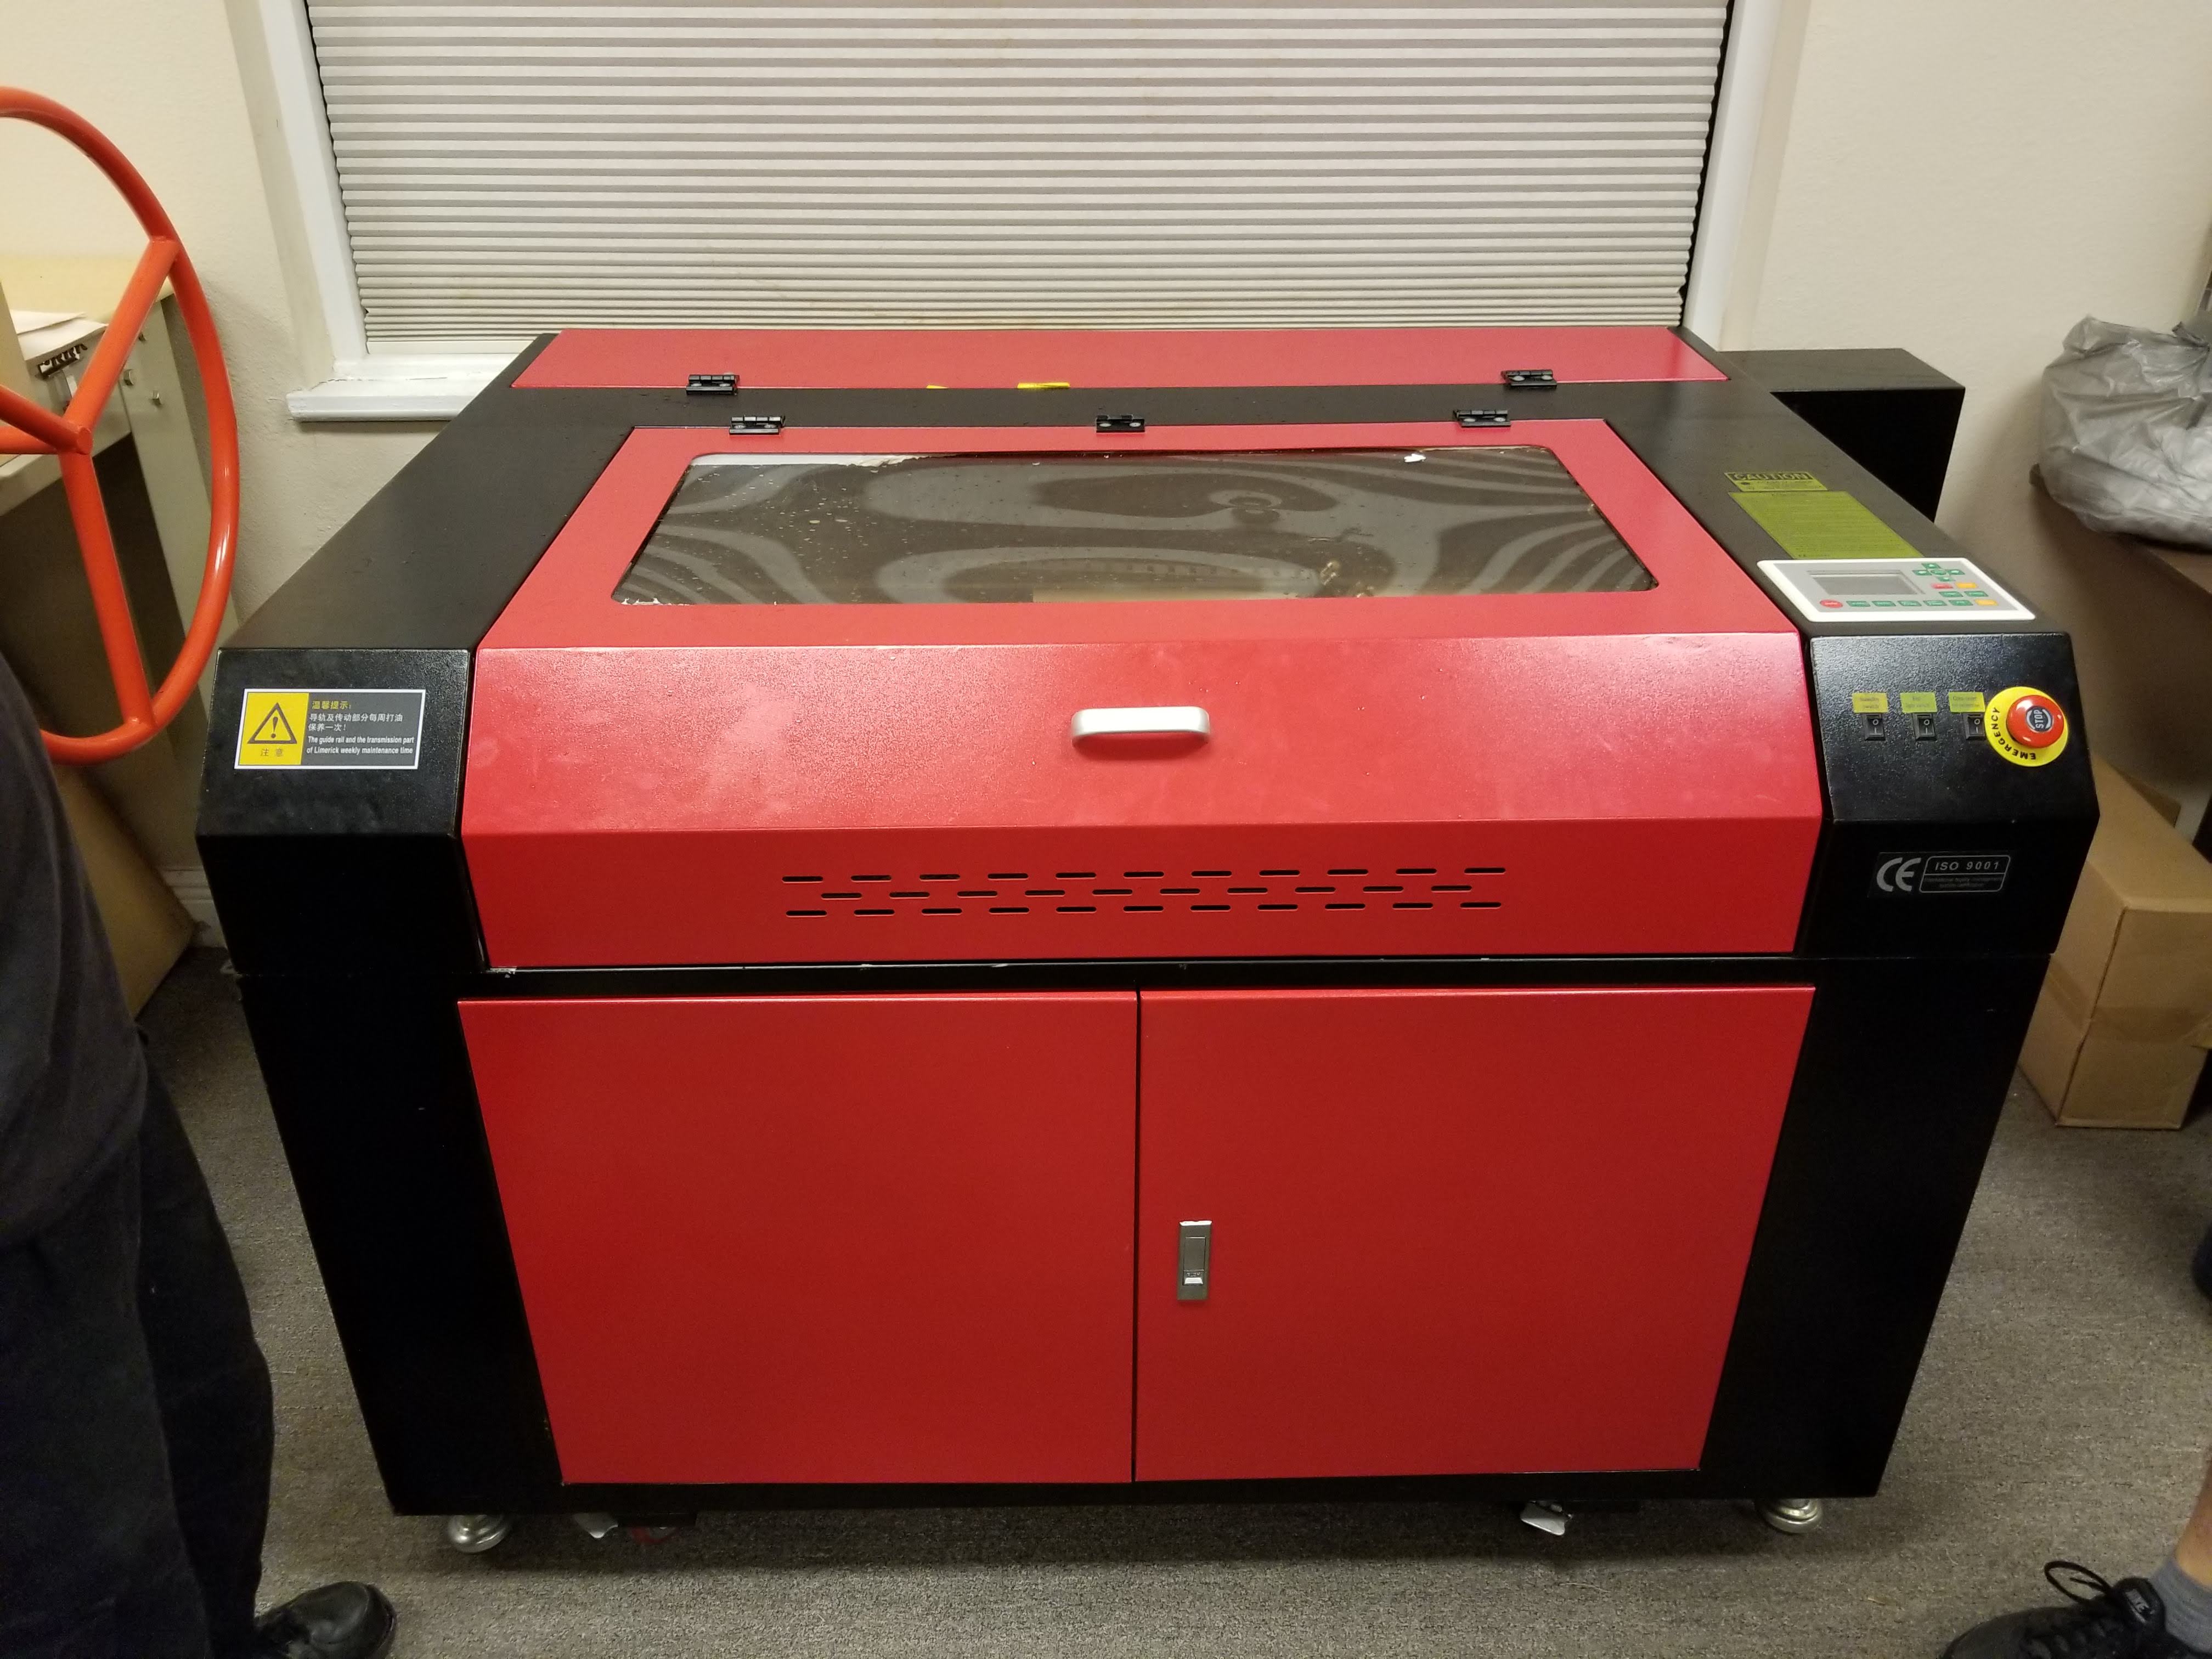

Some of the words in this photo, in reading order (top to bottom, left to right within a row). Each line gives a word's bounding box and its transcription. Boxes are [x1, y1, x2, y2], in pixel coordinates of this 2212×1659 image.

[2033, 709, 2044, 729] STOP
[319, 736, 335, 744] guide
[1991, 707, 2036, 760] EMERGENCY
[340, 747, 360, 755] weekly
[1935, 861, 1959, 871] ISO
[1966, 861, 2000, 870] 9001
[1876, 857, 1921, 892] CE
